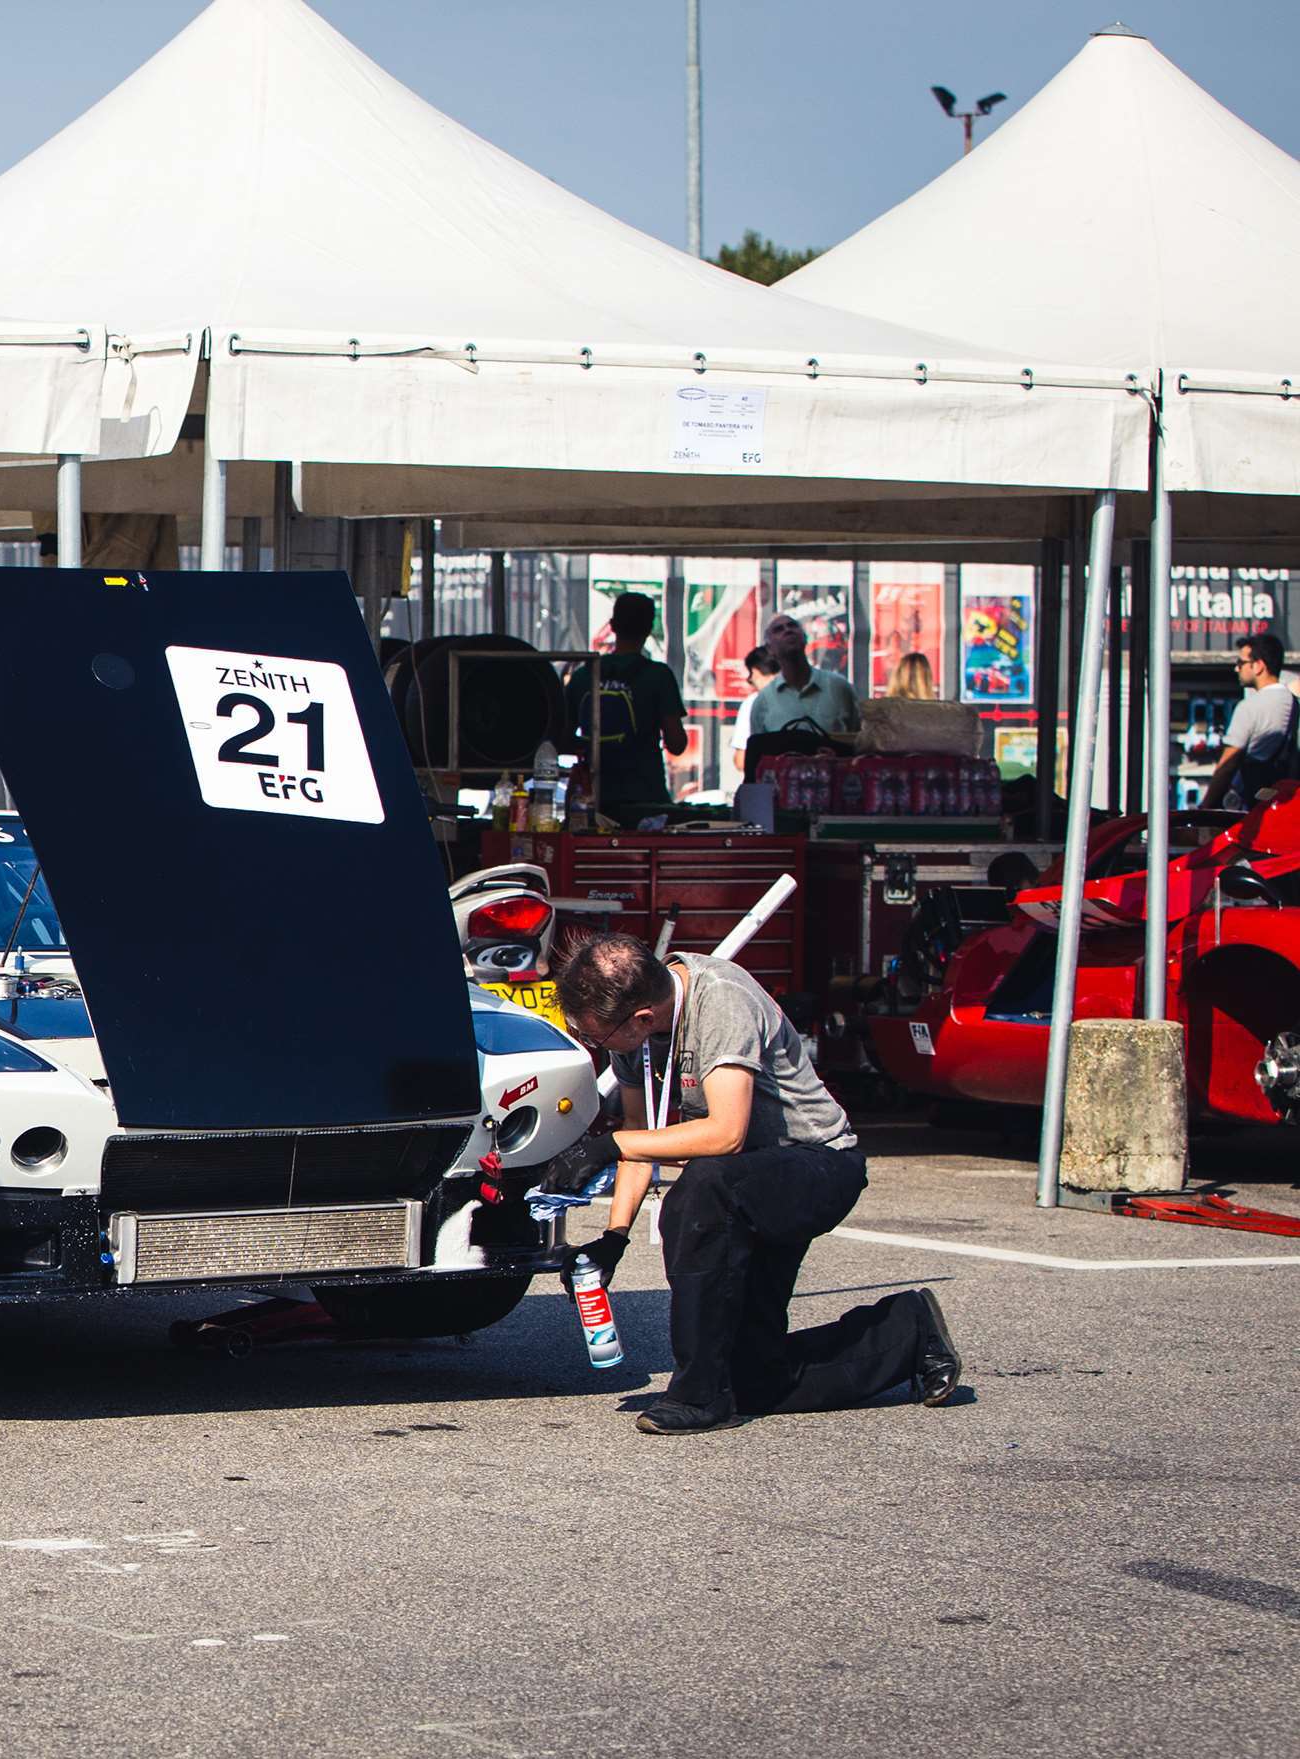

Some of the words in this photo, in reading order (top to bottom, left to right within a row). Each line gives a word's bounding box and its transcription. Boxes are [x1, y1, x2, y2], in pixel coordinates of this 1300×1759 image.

[742, 453, 761, 463] EFG
[215, 667, 311, 694] ZENITH
[216, 692, 325, 773] 21
[257, 772, 324, 803] EFG
[519, 1078, 535, 1096] BM
